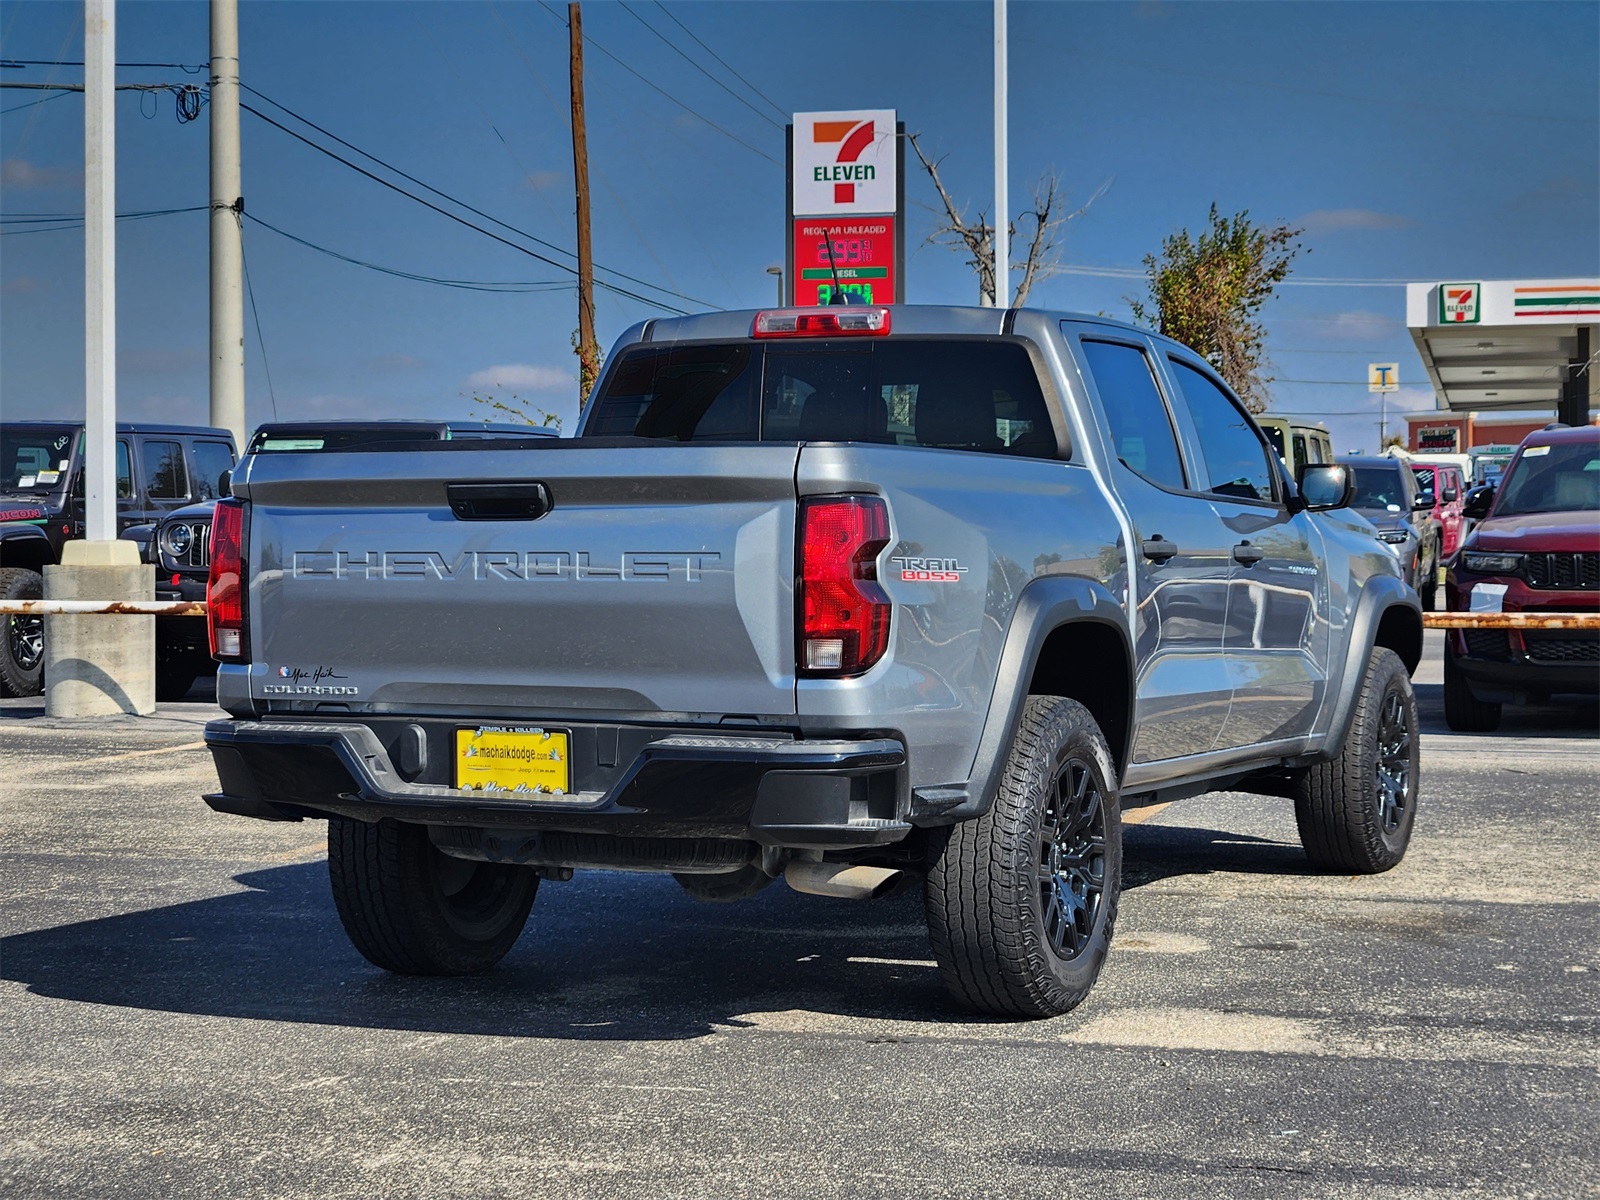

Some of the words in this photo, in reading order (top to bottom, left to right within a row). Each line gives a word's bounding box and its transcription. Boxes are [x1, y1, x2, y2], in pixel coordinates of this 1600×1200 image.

[843, 226, 886, 234] UNLEADED
[832, 269, 858, 278] IESEL
[293, 551, 721, 581] CHEVROLET
[891, 556, 969, 572] TRAIL
[902, 570, 959, 582] BOSS
[289, 668, 311, 684] Mac
[313, 666, 348, 684] Haik
[263, 685, 359, 695] COLORADO
[480, 745, 548, 762] machaikdodge.com
